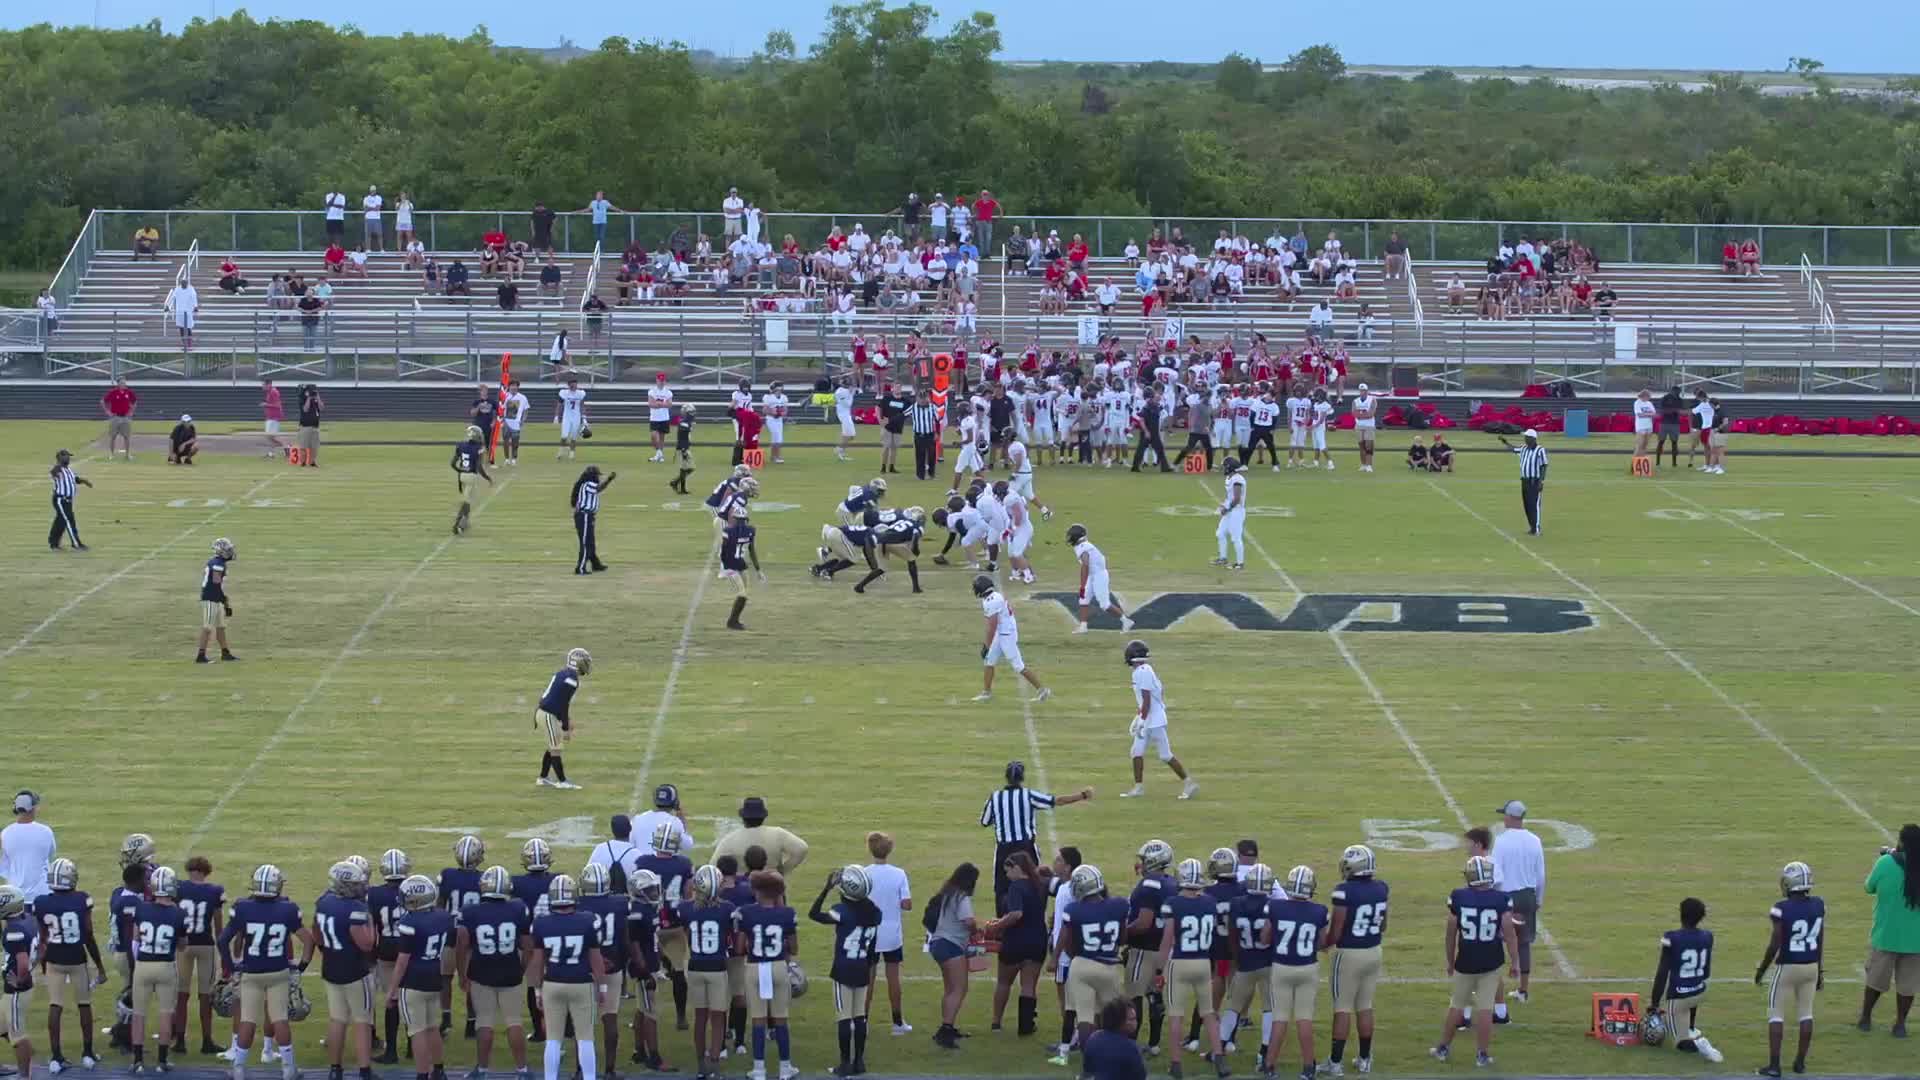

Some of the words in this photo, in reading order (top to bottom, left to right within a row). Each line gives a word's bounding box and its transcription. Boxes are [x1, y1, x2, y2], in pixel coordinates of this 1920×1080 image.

[1186, 455, 1202, 472] 50
[1635, 458, 1650, 474] 40
[1028, 590, 1601, 634] WB
[689, 919, 720, 955] 18
[1081, 920, 1121, 952] 53
[1181, 913, 1215, 953] 20
[1351, 902, 1387, 938] 65
[1460, 906, 1498, 942] 56
[1789, 917, 1823, 953] 24
[246, 922, 287, 957] 72
[543, 934, 585, 965] 77
[751, 924, 784, 958] 13
[1275, 920, 1317, 958] 70
[1679, 949, 1707, 978] 21
